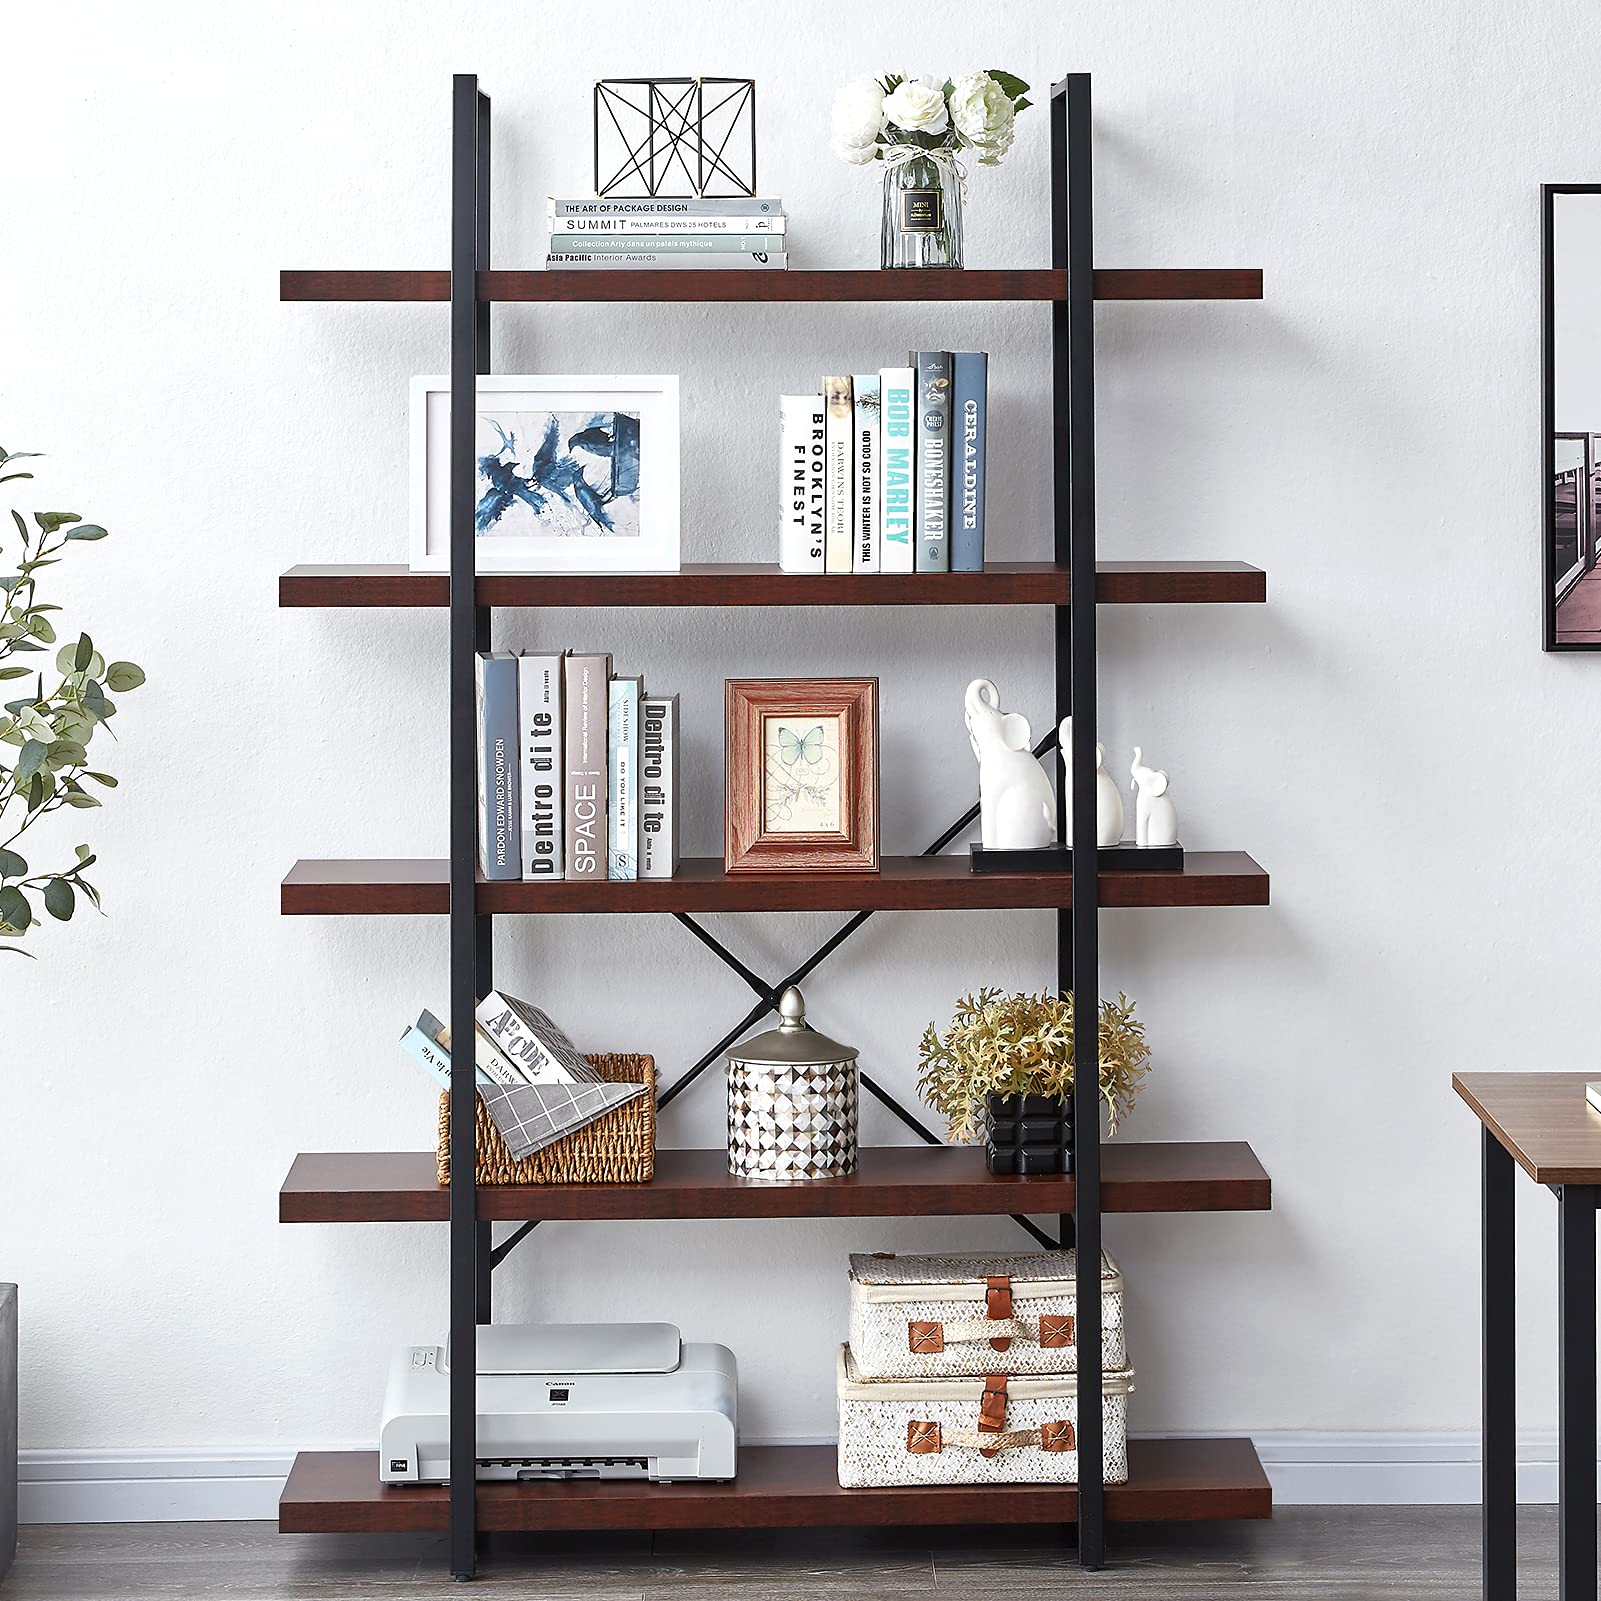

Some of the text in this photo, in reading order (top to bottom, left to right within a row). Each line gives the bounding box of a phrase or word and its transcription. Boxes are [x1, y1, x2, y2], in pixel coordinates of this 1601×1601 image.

[567, 220, 626, 229] SUMMIT
[794, 446, 805, 525] FINEST
[811, 414, 823, 558] BROOKLYN'S
[862, 430, 871, 563] THIS WINTER IS NOT SO COLOD
[886, 389, 909, 544] BOB MARLEY
[924, 438, 943, 541] BONESHAKER
[495, 739, 506, 866] PARDON EDWARD SNOWDEN
[530, 713, 554, 874] Dentro di te
[620, 762, 625, 774] DO
[644, 705, 666, 833] Dentro di te
[575, 784, 596, 873] SPACE
[422, 1046, 435, 1063] Vie
[436, 1061, 445, 1072] la
